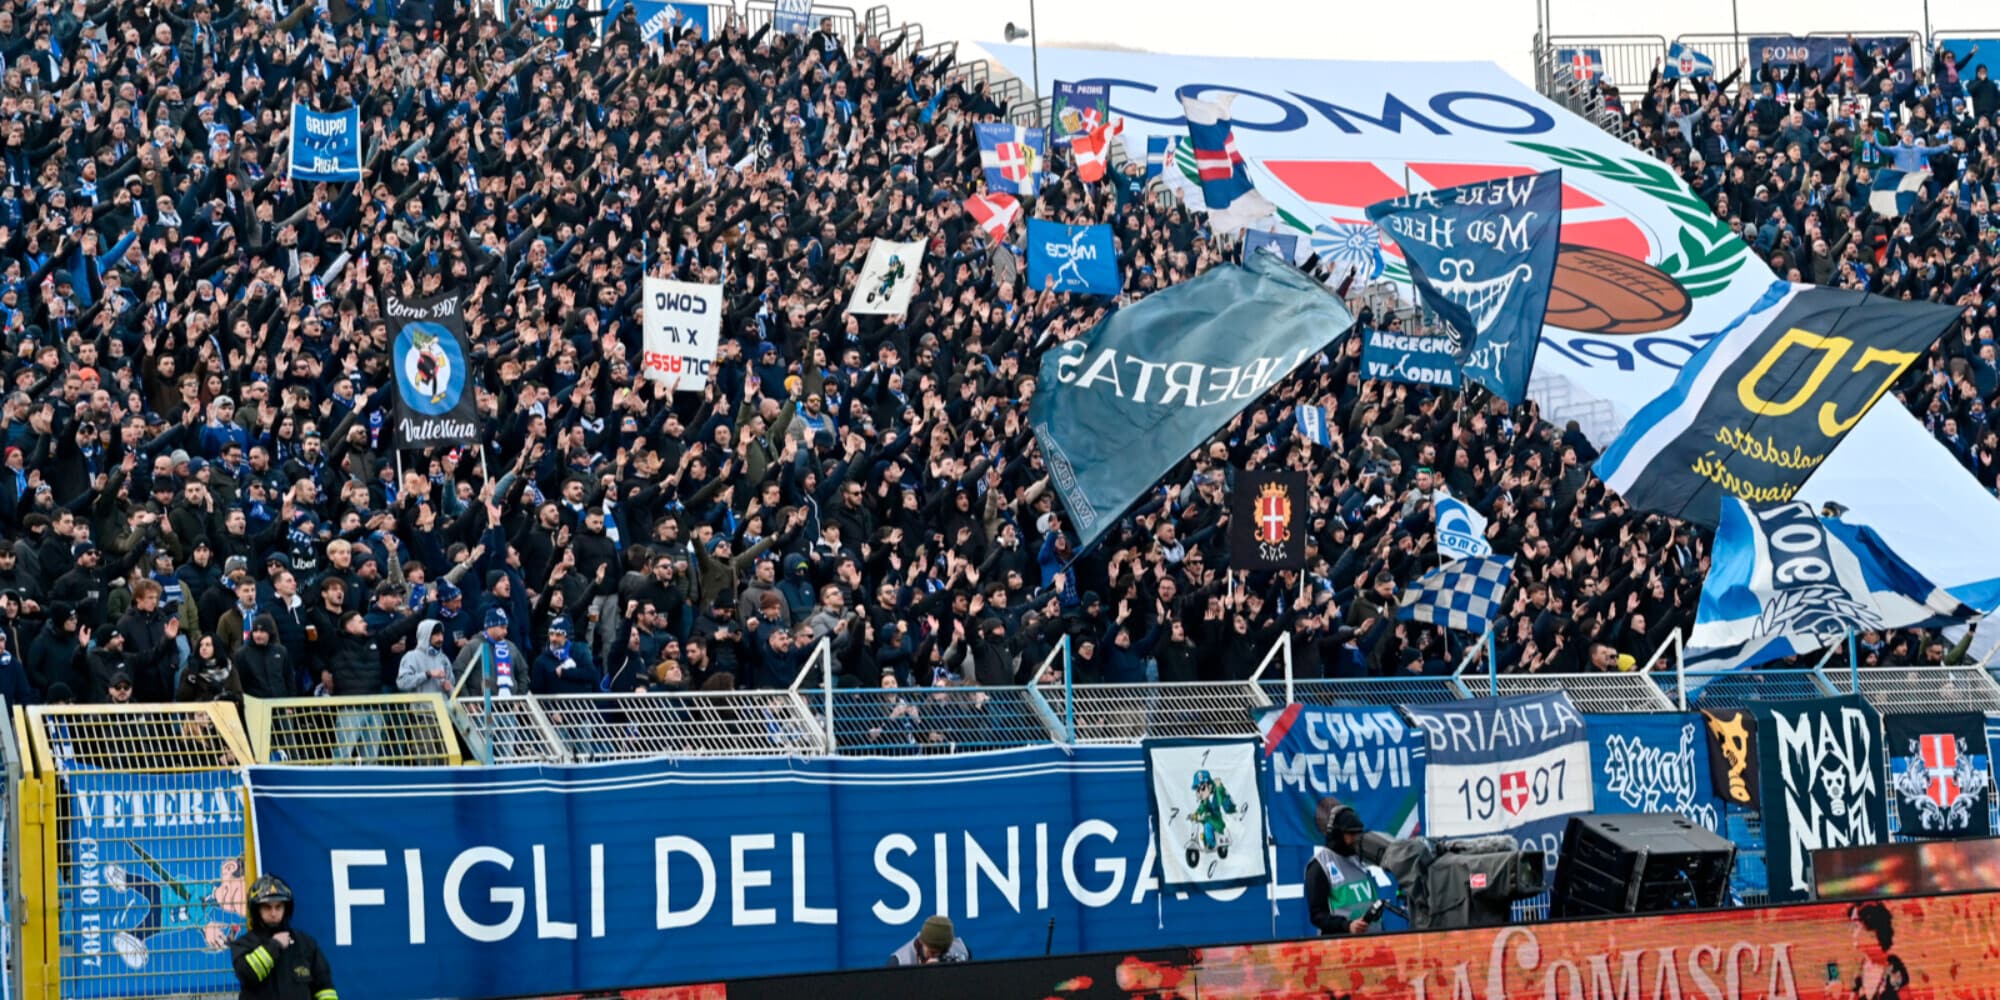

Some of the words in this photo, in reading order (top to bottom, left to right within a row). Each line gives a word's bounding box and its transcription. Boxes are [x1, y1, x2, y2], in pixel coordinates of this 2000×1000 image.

[1076, 78, 1556, 136] COMO
[305, 115, 347, 137] GRUPPO
[386, 296, 429, 319] Como
[432, 296, 459, 318] 1907
[655, 292, 708, 315] COMO
[663, 326, 681, 343] IL
[1369, 331, 1455, 355] ARGEGNO
[644, 351, 712, 376] OLLASSO
[1407, 366, 1453, 386] ODIA
[400, 418, 476, 443] Valtellina
[292, 557, 317, 570] Uber
[1304, 711, 1405, 752] COMO
[1419, 690, 1584, 752] BRIANZA
[1770, 705, 1877, 798] MAD
[1272, 747, 1412, 793] MCMVII
[79, 836, 101, 905] COMO
[330, 842, 606, 946] FIGLI
[655, 832, 839, 931] DEL
[1348, 881, 1373, 903] TV
[81, 913, 102, 968] 1907
[1484, 926, 1803, 1000] COMASCA
